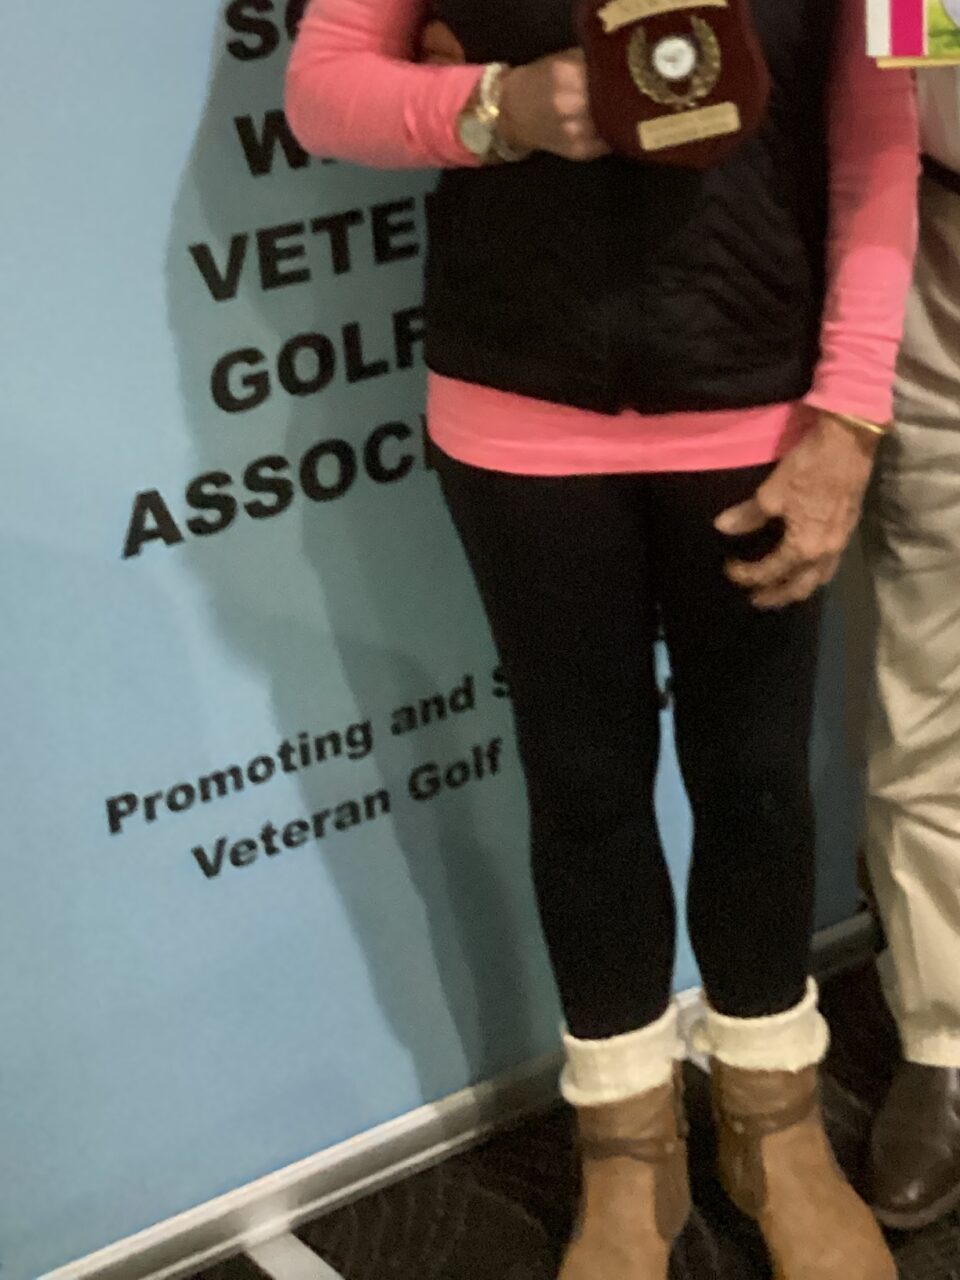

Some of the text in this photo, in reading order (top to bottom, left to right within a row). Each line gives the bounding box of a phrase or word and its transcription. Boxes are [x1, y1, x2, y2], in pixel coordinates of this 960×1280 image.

[187, 192, 430, 303] VETE
[105, 674, 476, 835] Promoting and
[191, 737, 502, 880] Veteran Golf
